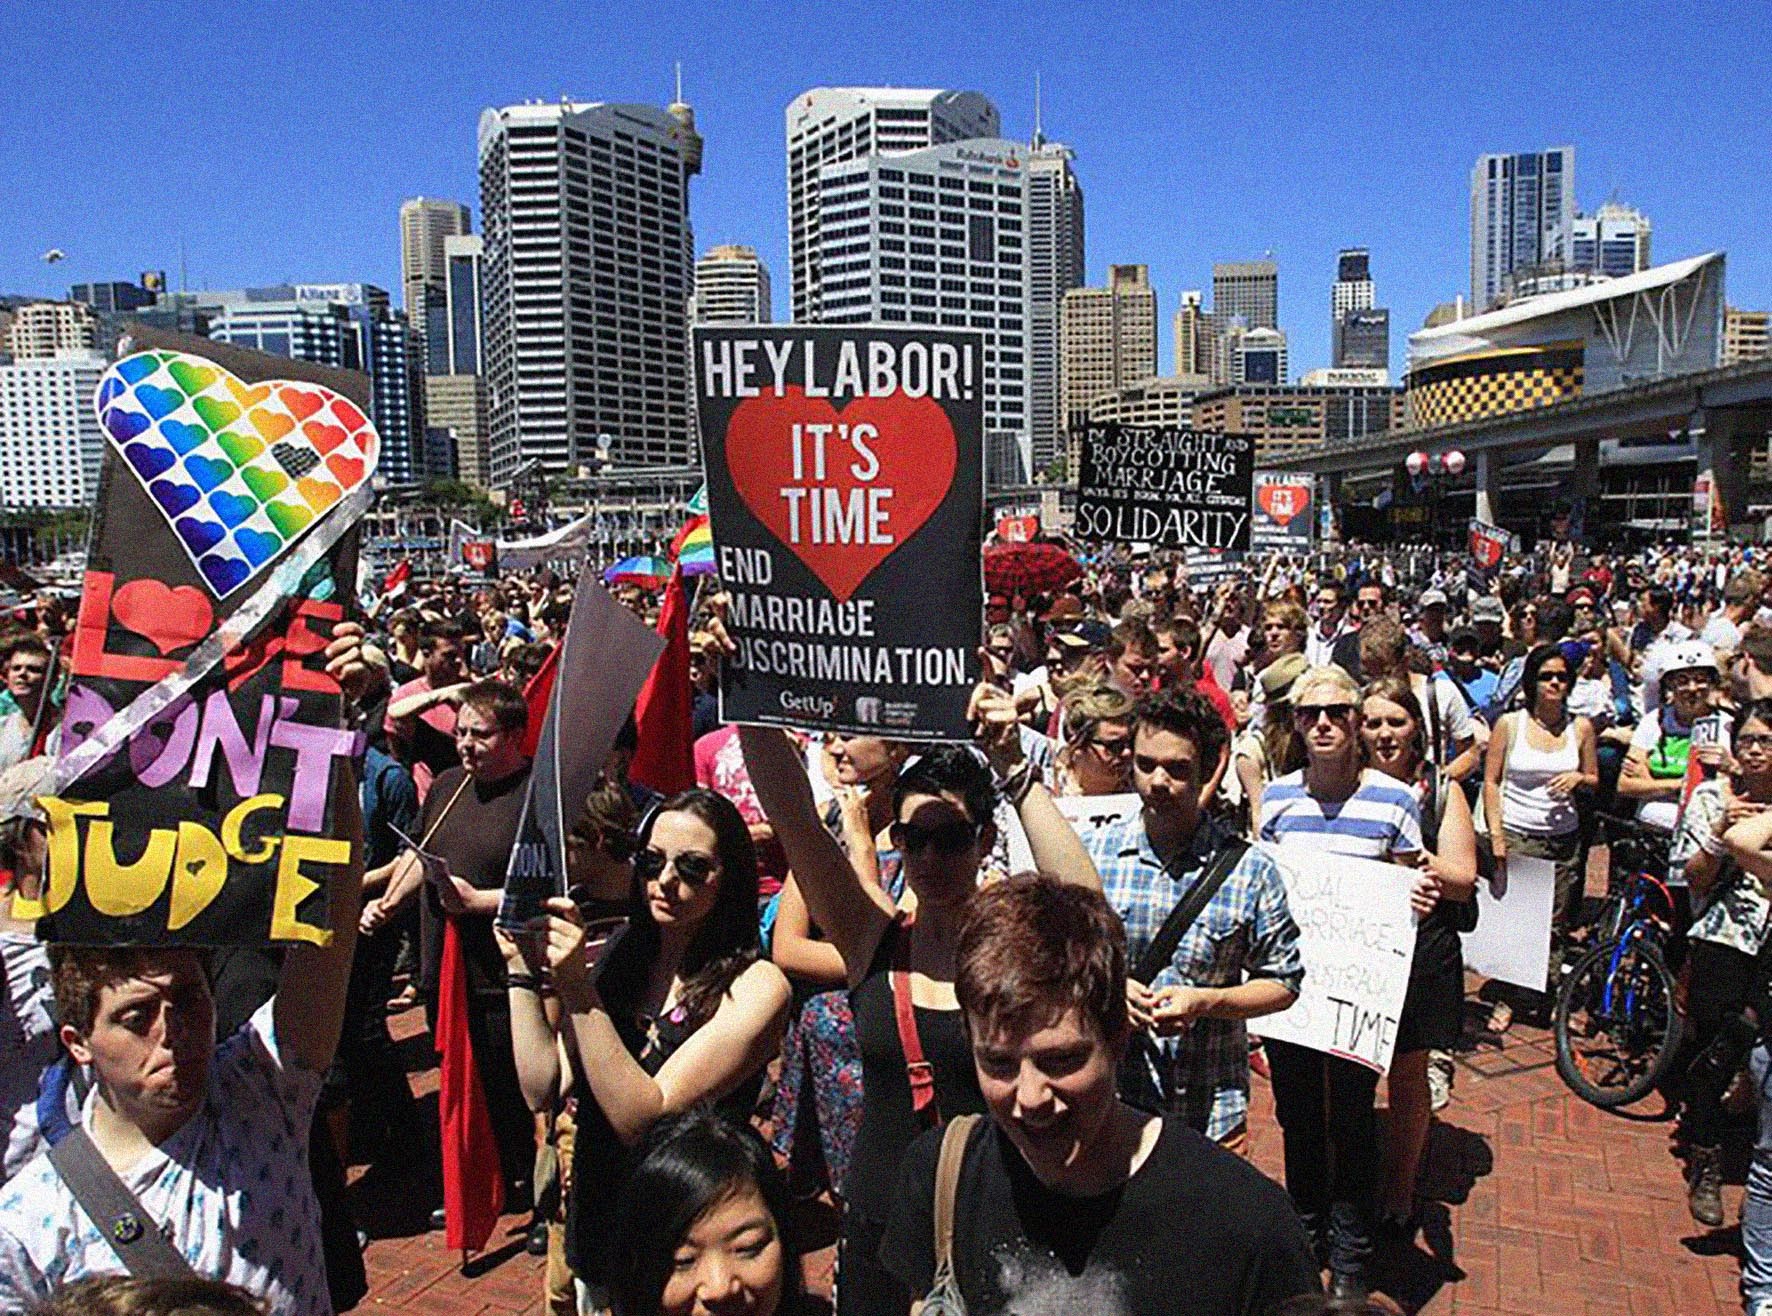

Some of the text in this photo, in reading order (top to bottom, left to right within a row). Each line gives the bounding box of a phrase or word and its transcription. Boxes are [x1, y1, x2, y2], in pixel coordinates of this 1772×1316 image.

[703, 340, 973, 400] HEY LABOR!
[791, 423, 880, 482] IT'S
[1091, 444, 1236, 475] BOYCOTTING
[1116, 428, 1224, 453] STRAIGHT
[1095, 463, 1227, 494] MARRIAGE
[779, 487, 894, 544] TIME
[1077, 502, 1247, 548] SOLIDARITY
[720, 546, 772, 585] END
[727, 592, 875, 637] MARRIAGE
[731, 636, 975, 686] DISCRIMINATION.
[60, 683, 366, 832] DON'T
[12, 793, 350, 947] JUDGE
[1326, 994, 1397, 1064] TIME
